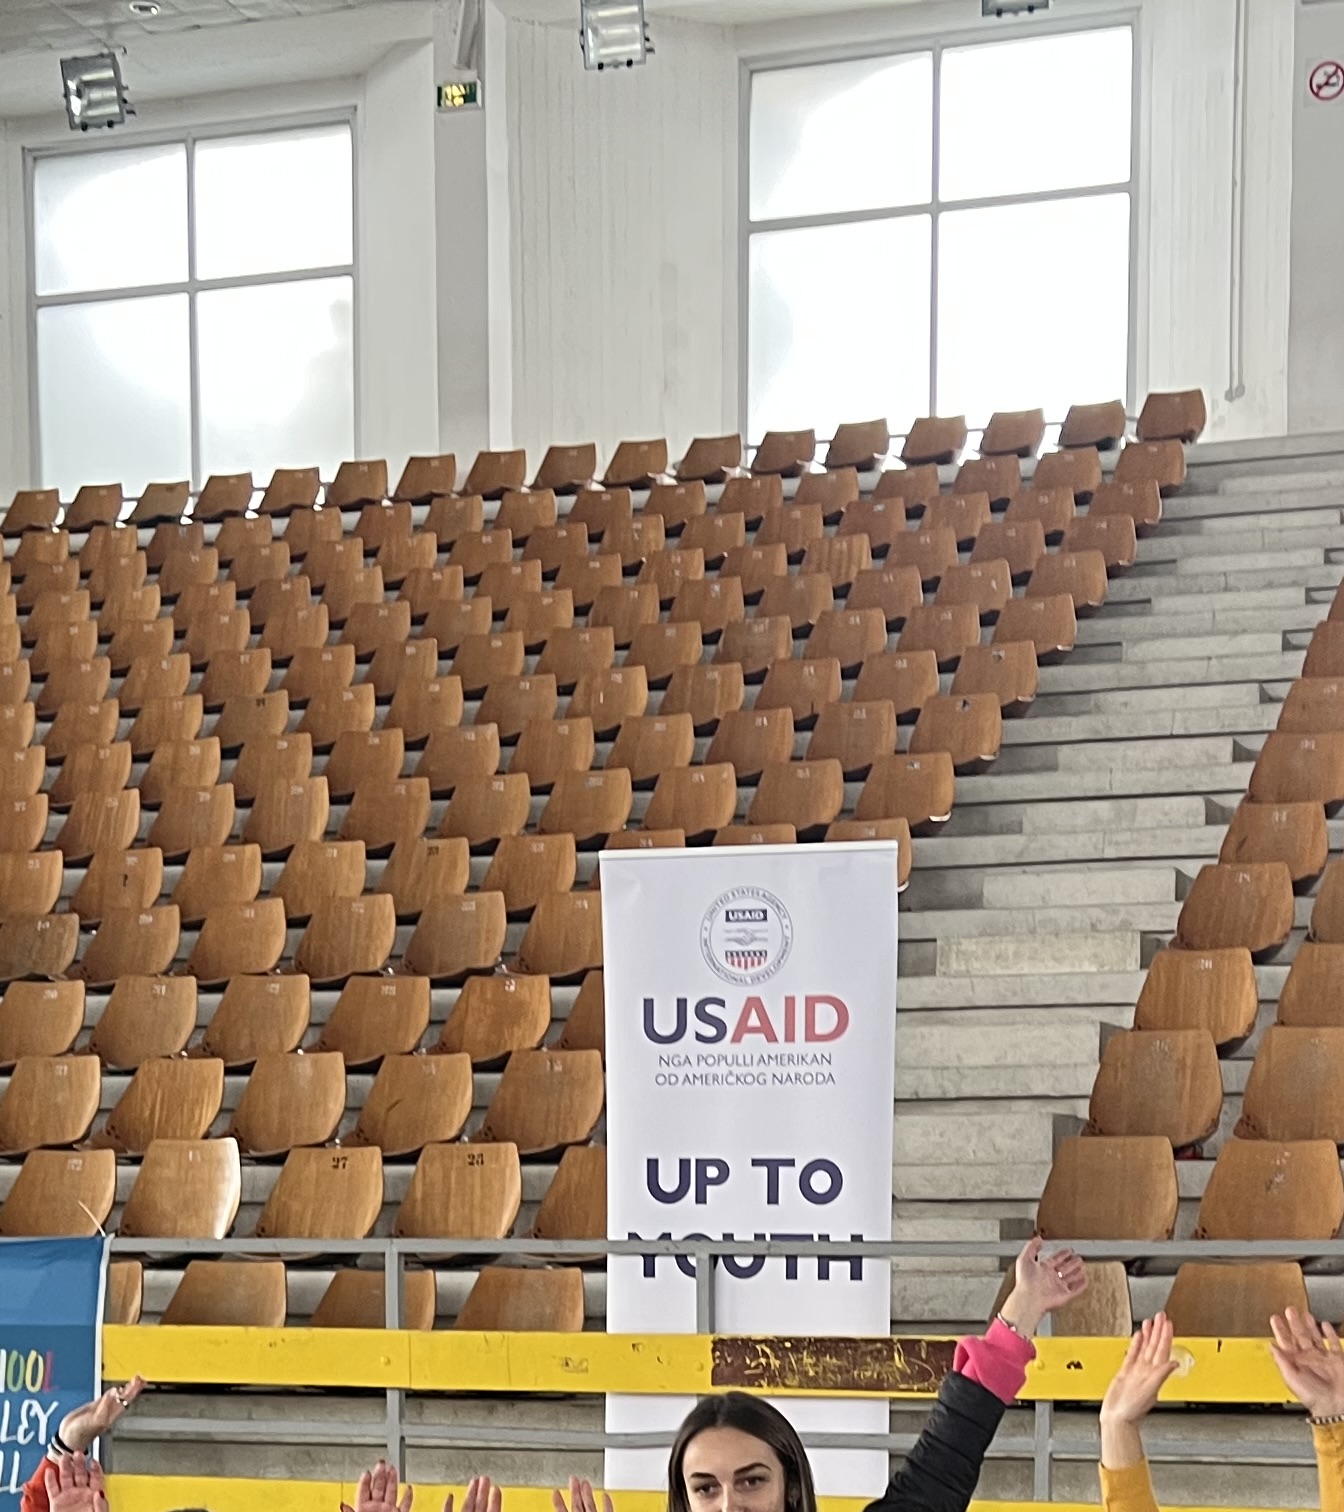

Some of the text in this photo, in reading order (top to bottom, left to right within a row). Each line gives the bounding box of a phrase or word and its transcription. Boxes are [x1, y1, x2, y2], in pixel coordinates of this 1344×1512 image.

[728, 911, 764, 921] USAID
[642, 995, 850, 1045] USAID
[658, 1052, 833, 1068] NGA POPULLI AMERIKAN
[655, 1070, 836, 1087] OD AMERIČKOG NARODA
[646, 1157, 844, 1206] UP TO
